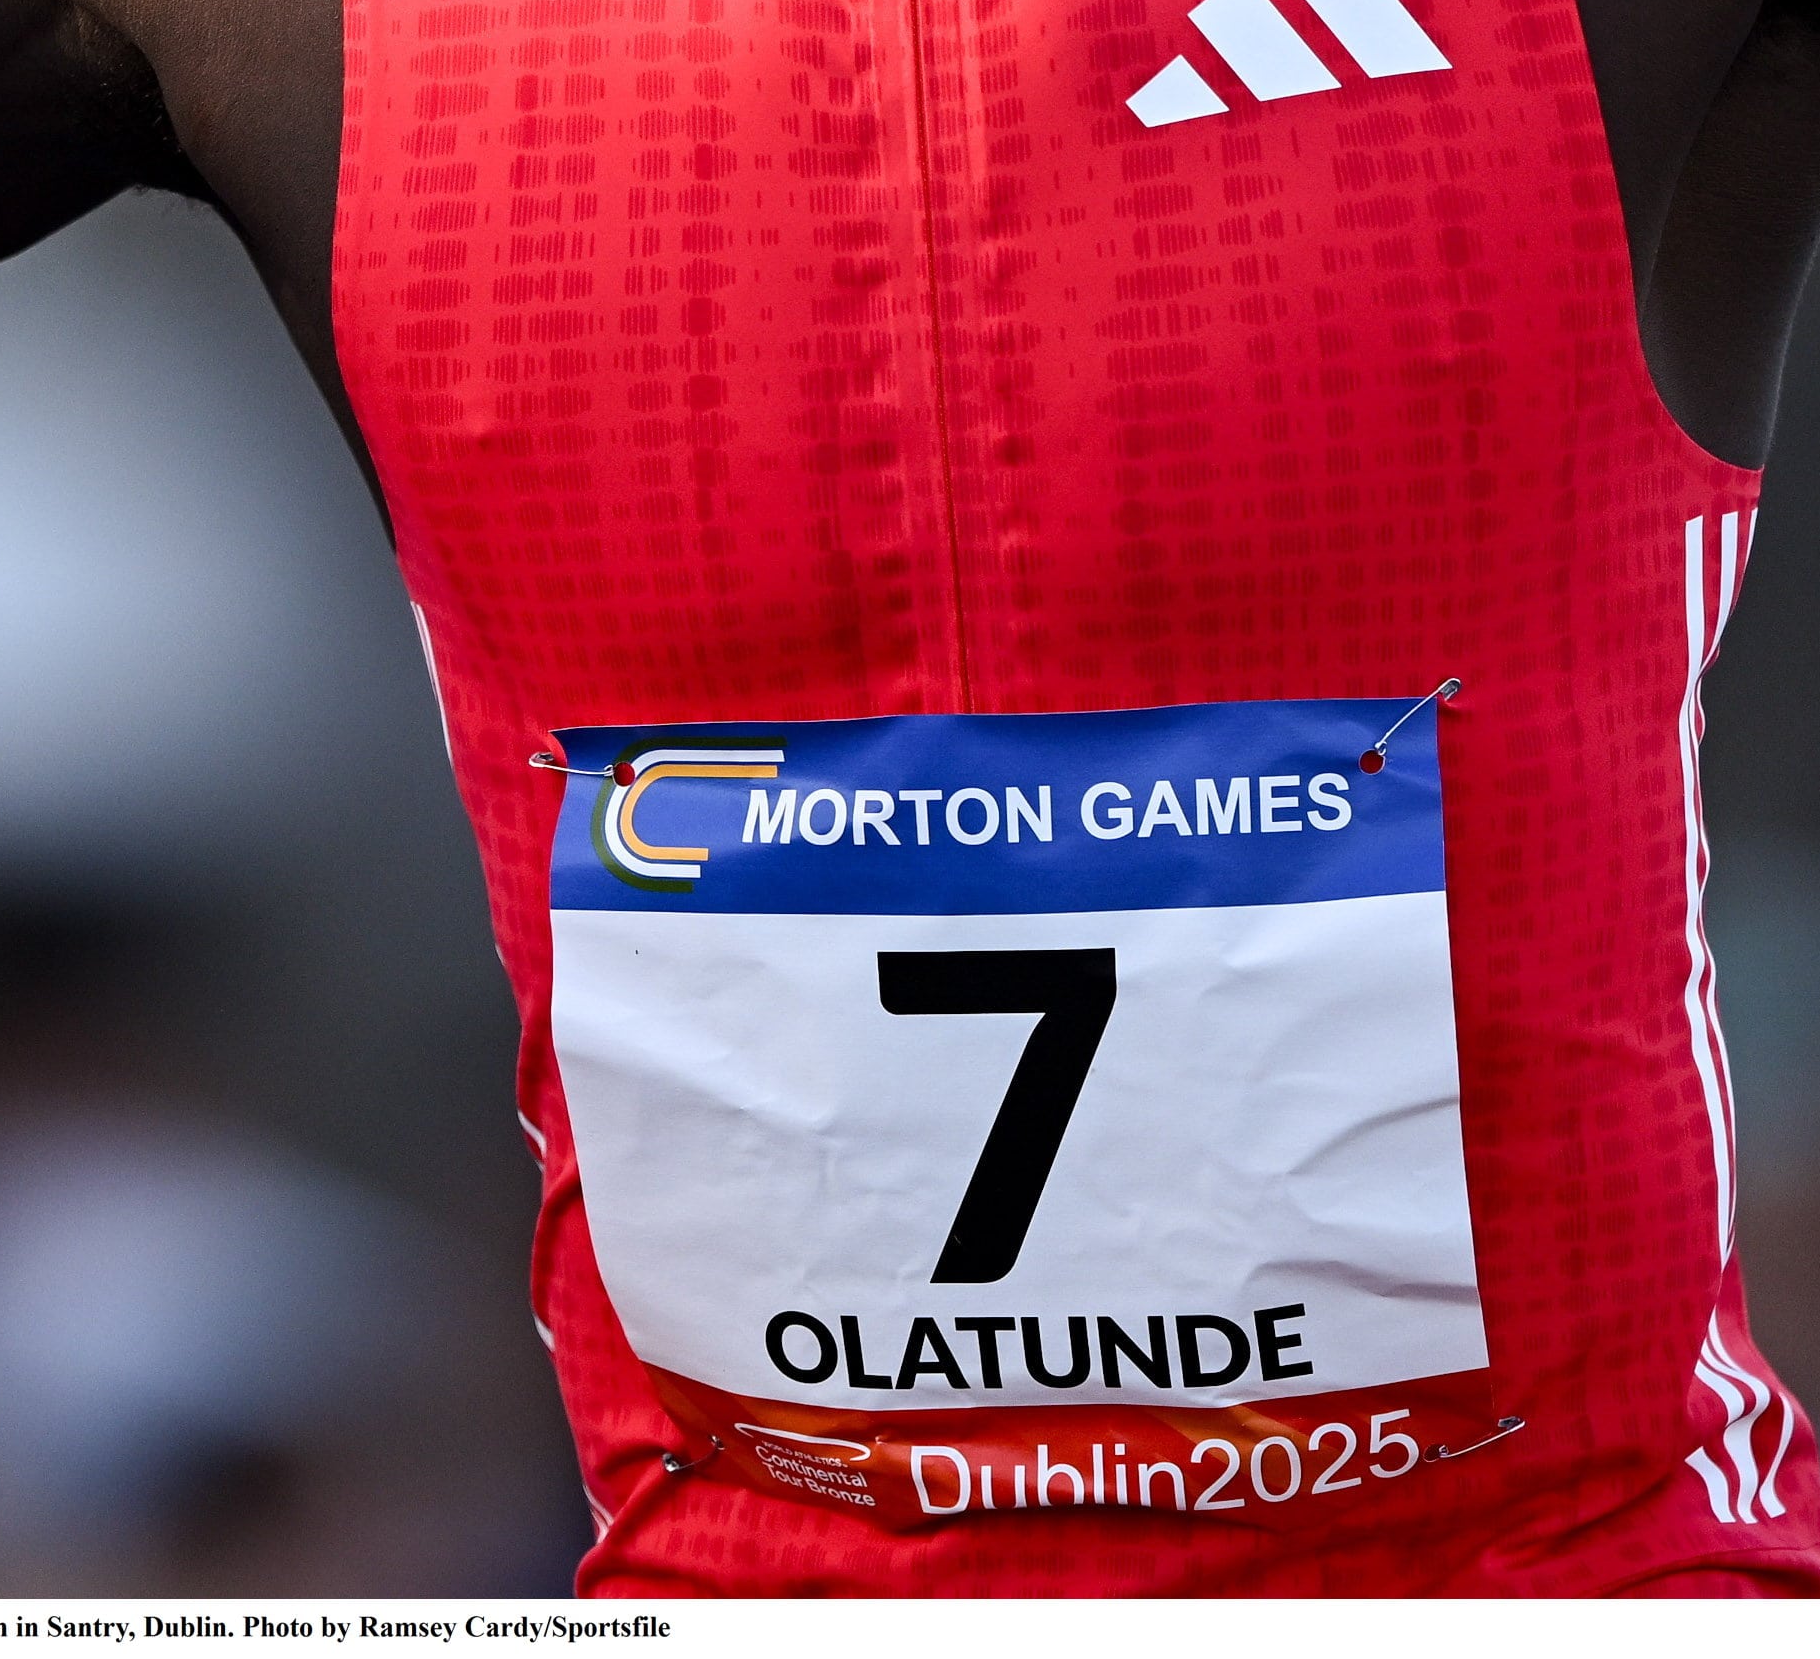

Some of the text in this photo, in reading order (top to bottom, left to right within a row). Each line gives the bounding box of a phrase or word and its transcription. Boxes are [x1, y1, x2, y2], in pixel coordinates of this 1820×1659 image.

[741, 772, 1353, 847] MORTON GAMES
[876, 947, 1118, 1285] 7
[764, 1303, 1314, 1391] OLATUNDE
[755, 1445, 868, 1488] Continental
[762, 1461, 877, 1507] Tour Bronze
[910, 1408, 1420, 1514] Dublin2025
